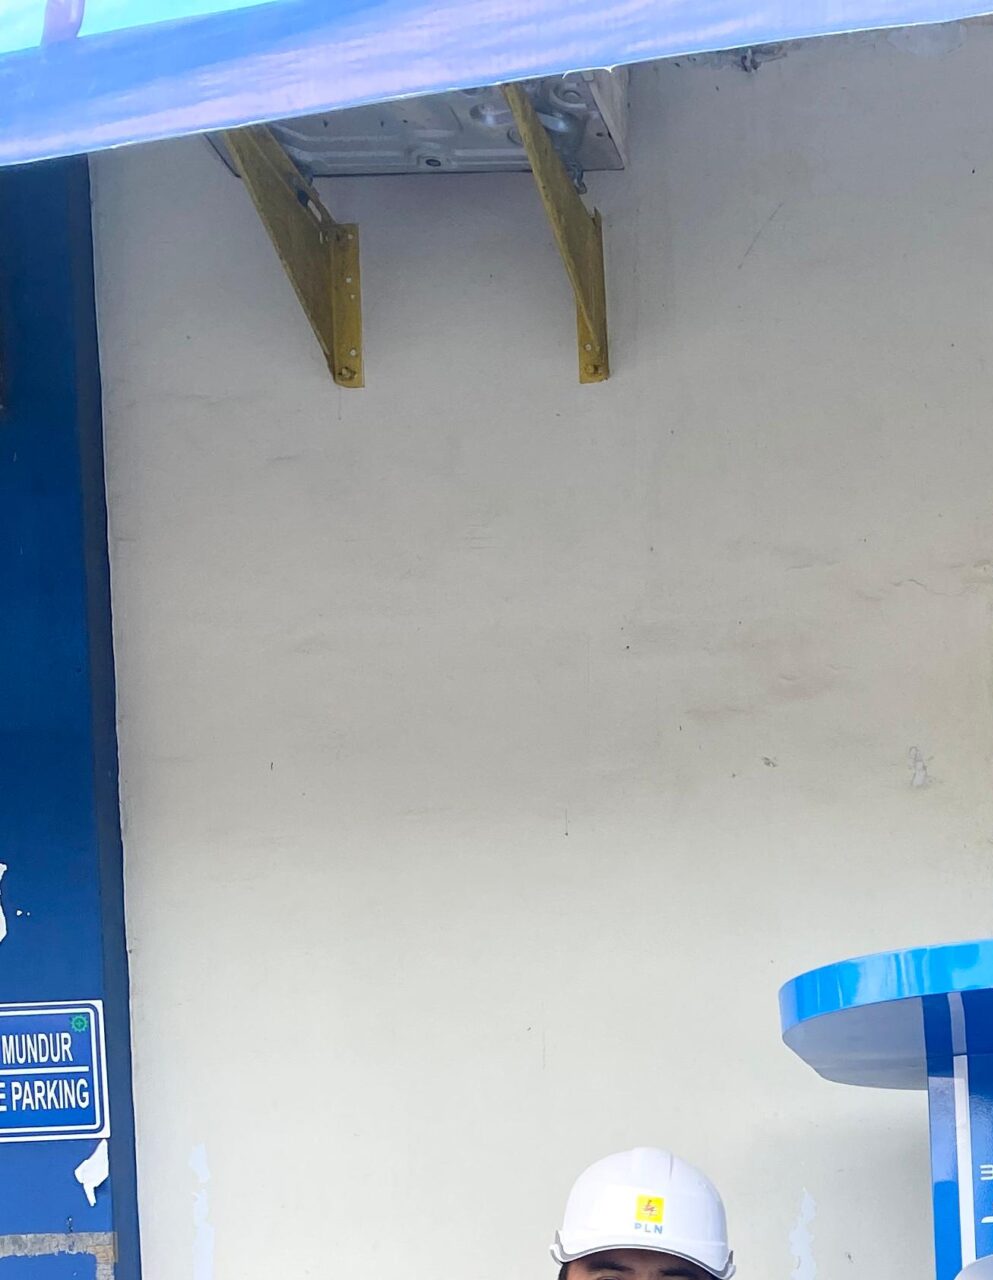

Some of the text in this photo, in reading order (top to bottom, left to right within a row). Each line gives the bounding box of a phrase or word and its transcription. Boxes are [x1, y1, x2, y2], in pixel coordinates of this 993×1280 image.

[1, 1032, 74, 1065] MUNDUR
[11, 1078, 90, 1112] PARKING
[634, 1222, 663, 1235] PLN
